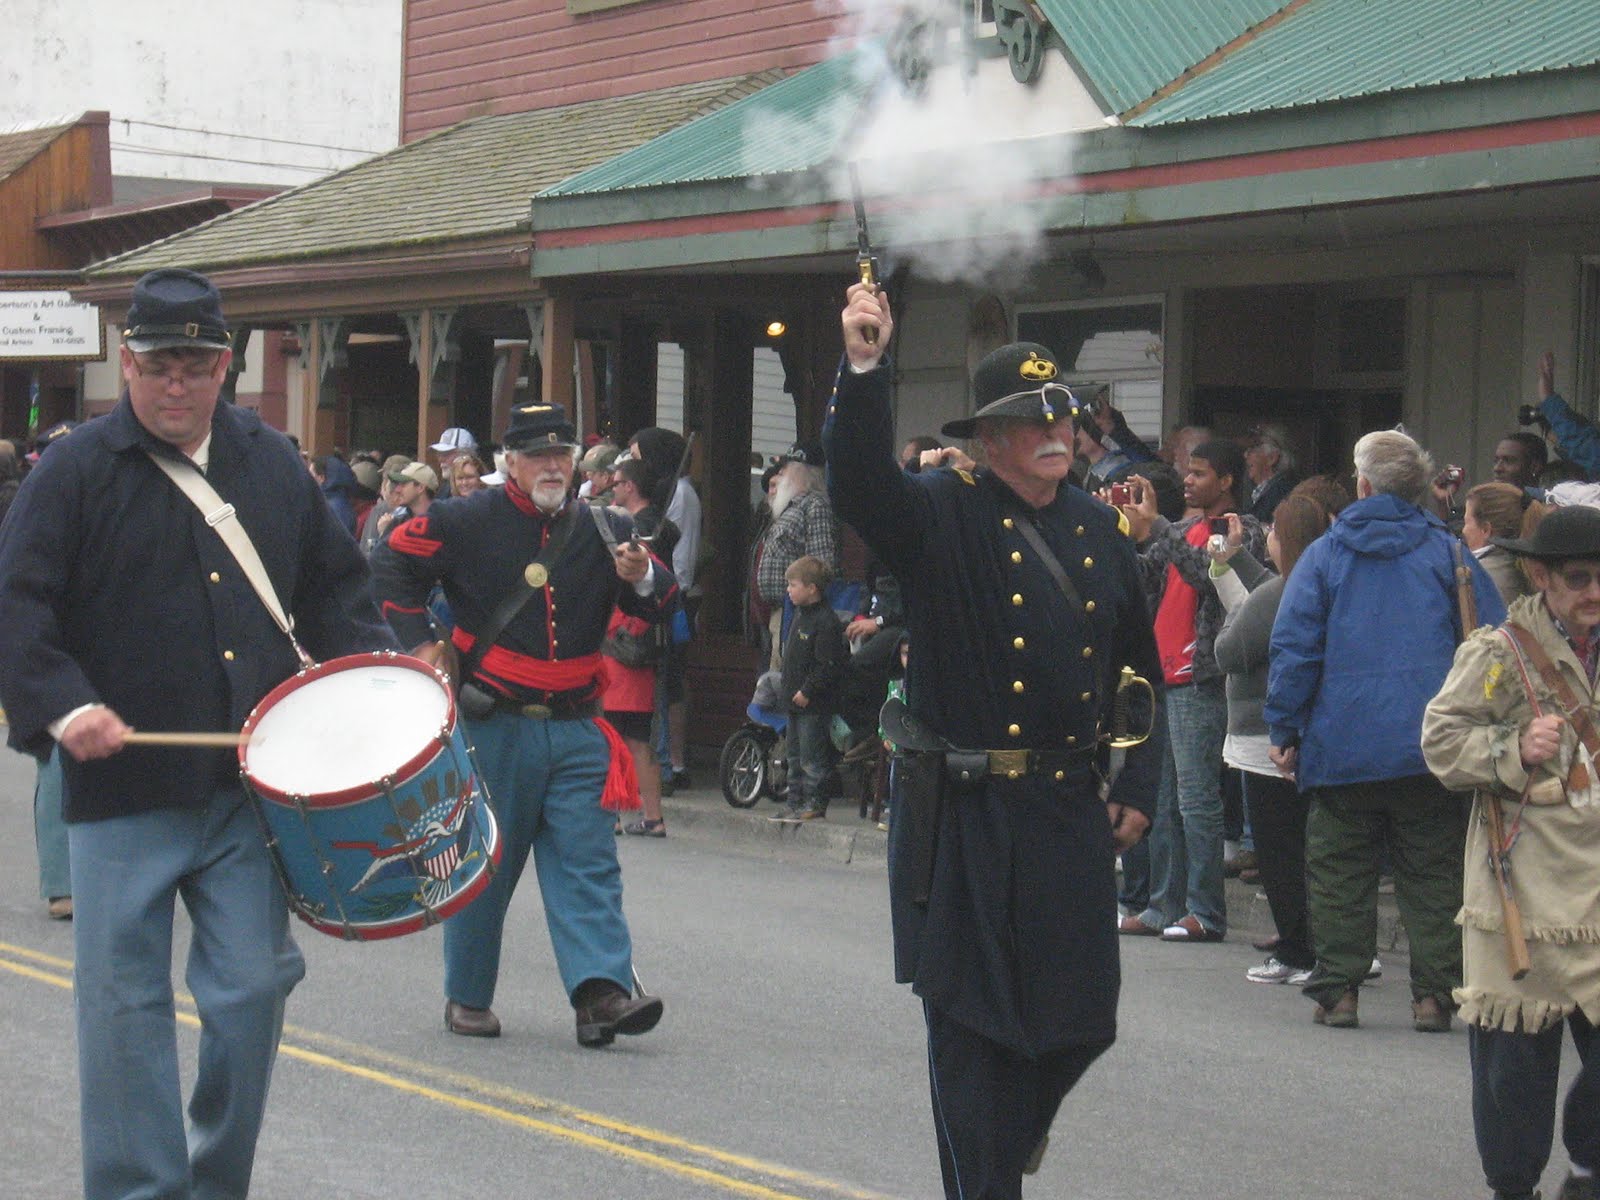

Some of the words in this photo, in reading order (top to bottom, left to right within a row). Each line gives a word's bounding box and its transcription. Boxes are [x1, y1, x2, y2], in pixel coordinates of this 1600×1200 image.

[41, 299, 54, 308] Art
[2, 326, 36, 335] Custom
[39, 325, 73, 336] Framing
